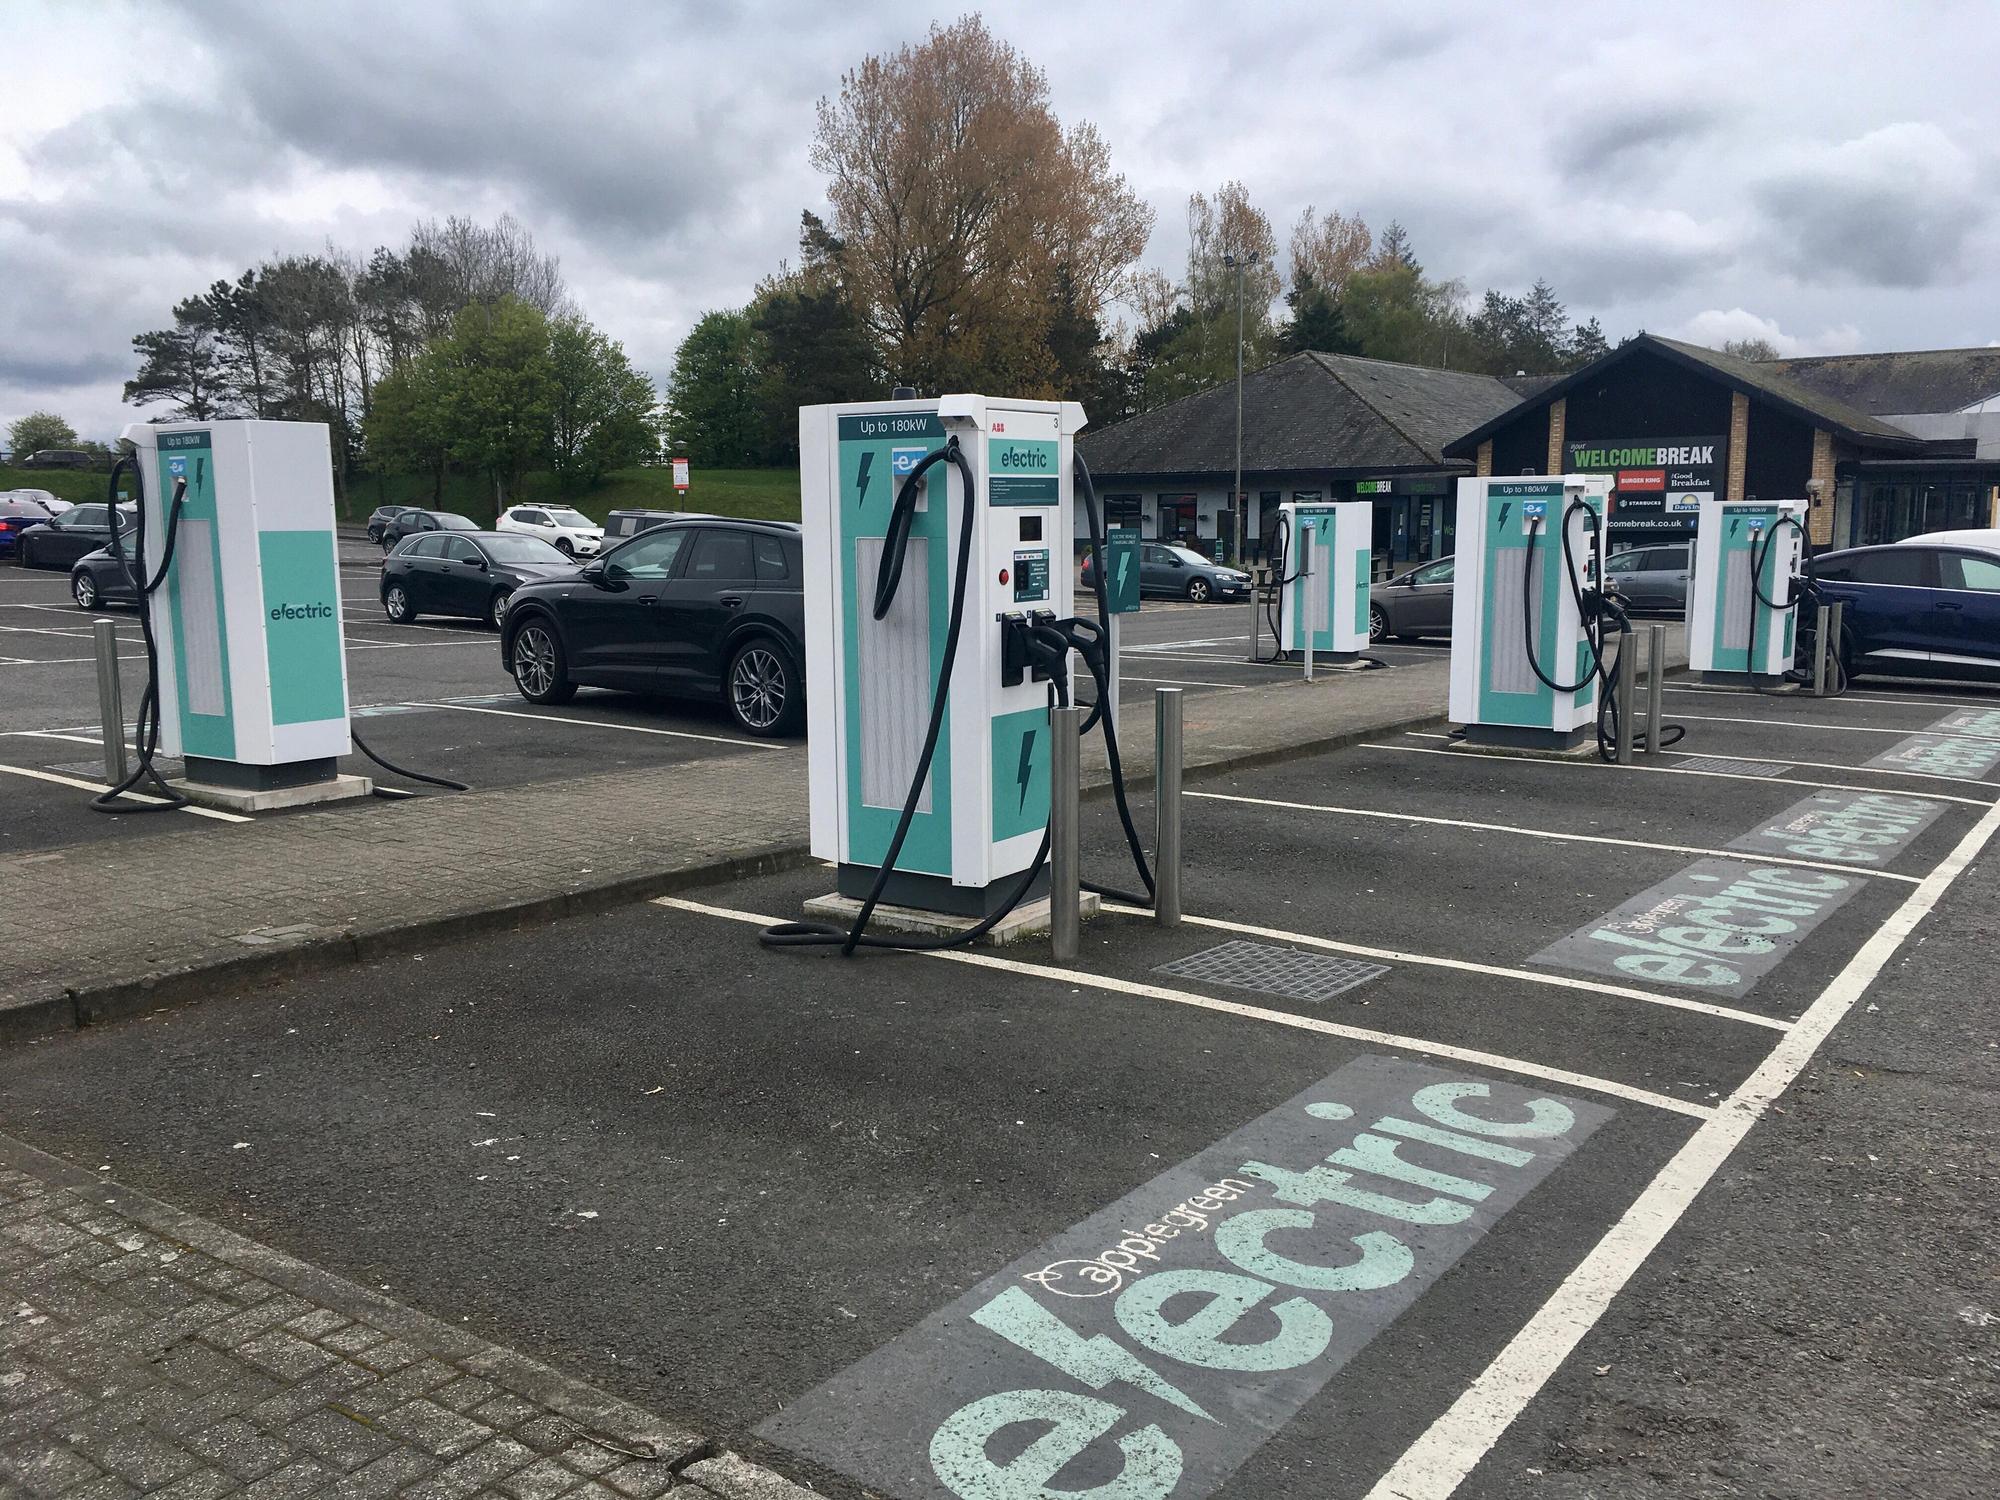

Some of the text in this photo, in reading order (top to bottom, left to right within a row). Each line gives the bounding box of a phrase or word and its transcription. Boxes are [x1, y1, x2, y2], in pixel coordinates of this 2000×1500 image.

[860, 418, 927, 436] Up to 180kW
[991, 423, 1004, 432] ABB
[1053, 417, 1059, 429] 3
[167, 435, 200, 447] Up to 180kW
[1001, 446, 1047, 468] electric
[1574, 446, 1714, 467] WELCOMEBREAK
[1671, 479, 1710, 487] Breakfast
[1674, 472, 1693, 480] Good
[1503, 486, 1513, 494] Up
[1524, 485, 1549, 493] 180kW
[1607, 519, 1682, 528] comebreak.co.uk
[271, 602, 332, 620] electric
[1588, 868, 1849, 986] electric
[1077, 1177, 1256, 1285] applegreen
[930, 1081, 1576, 1500] electric
